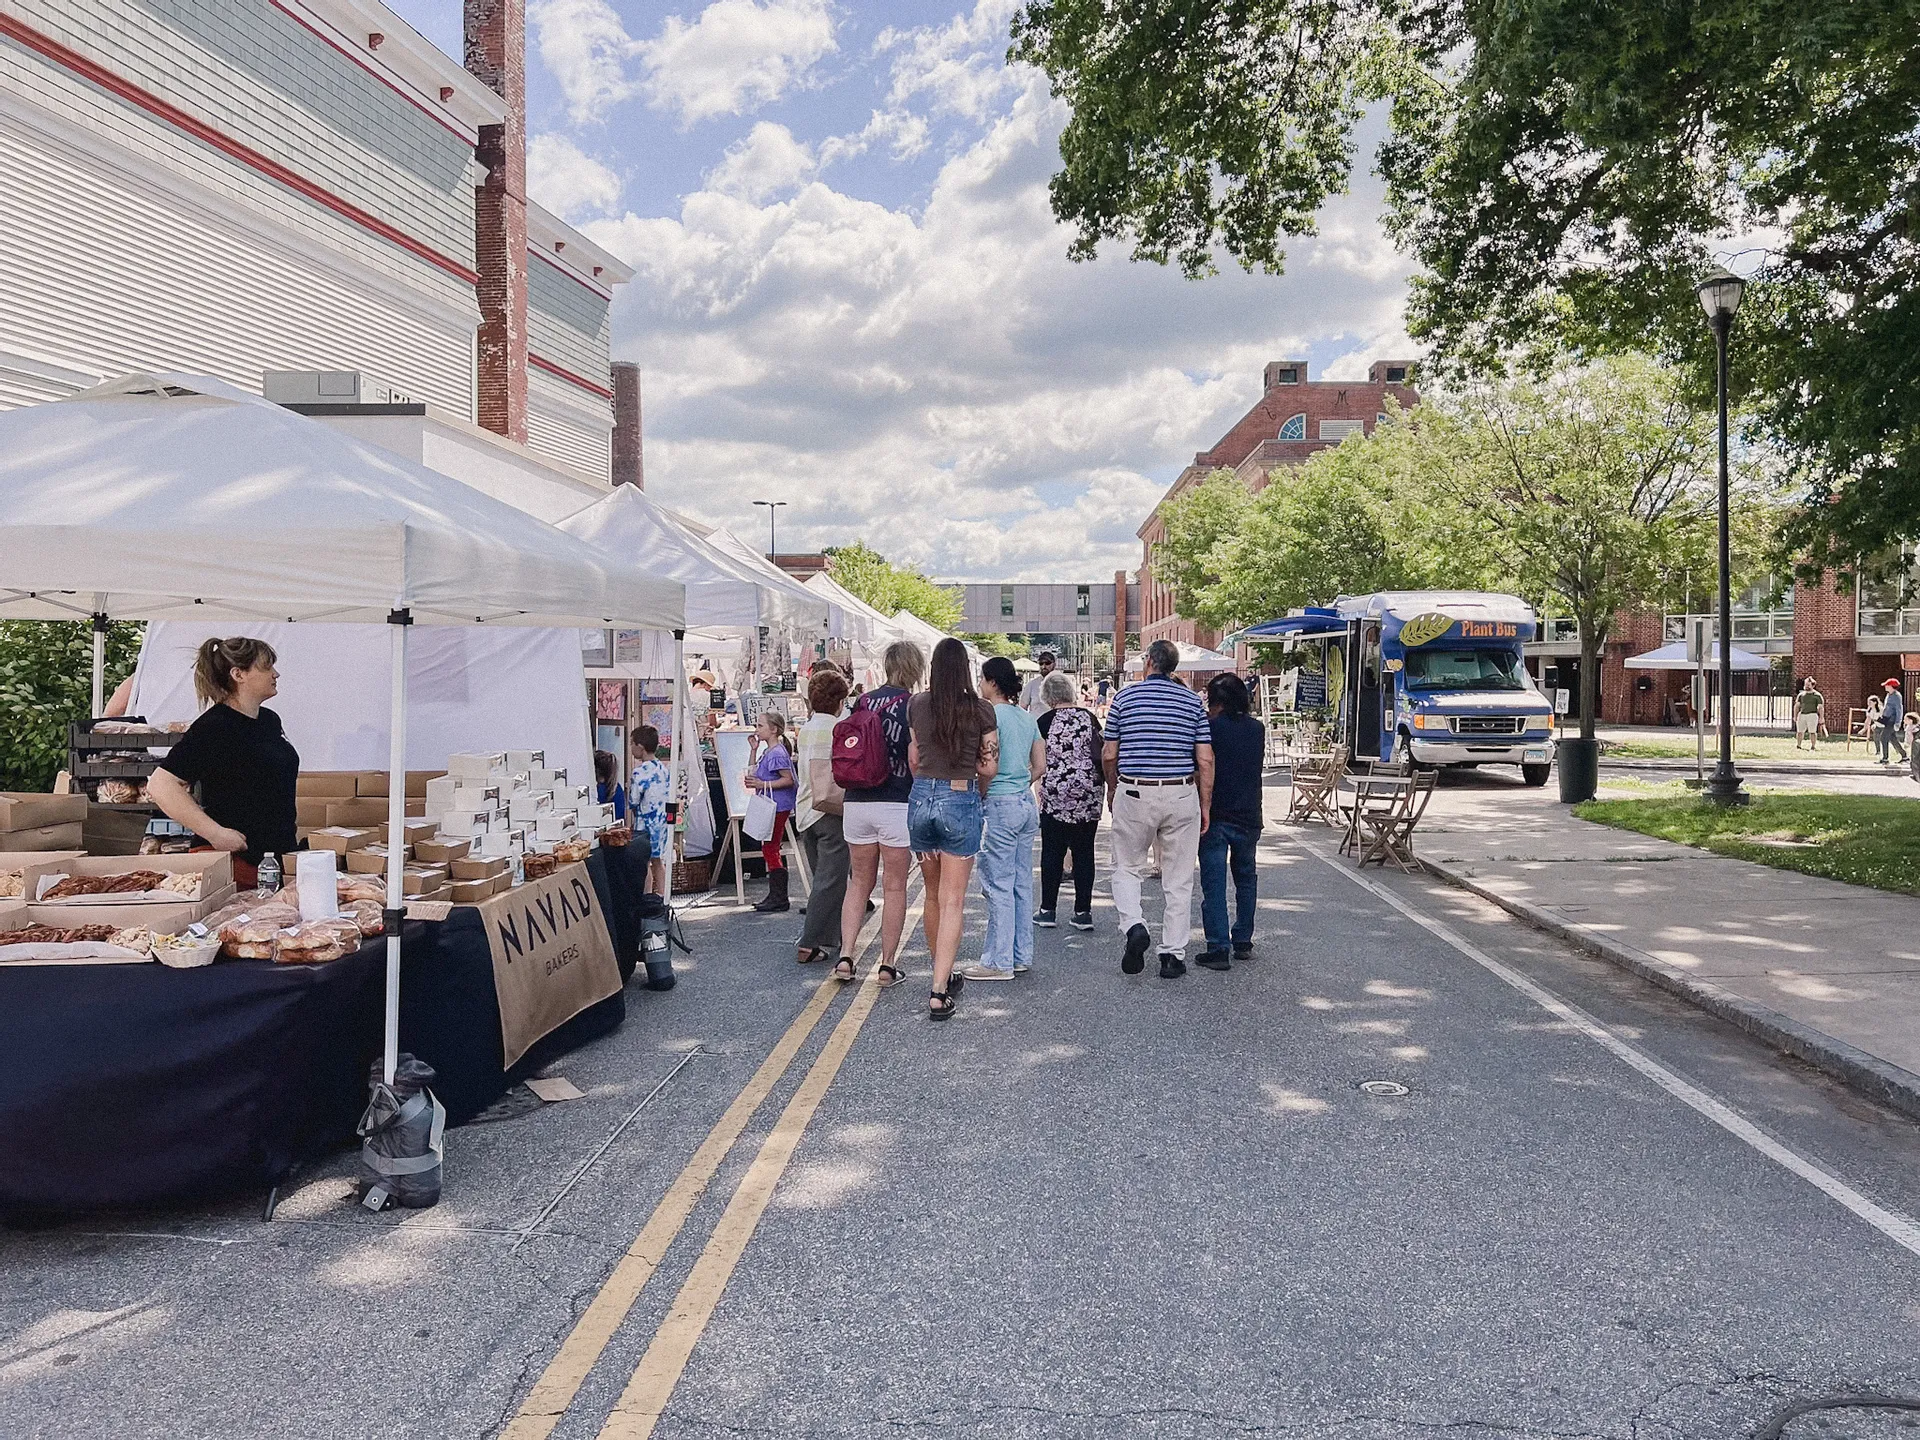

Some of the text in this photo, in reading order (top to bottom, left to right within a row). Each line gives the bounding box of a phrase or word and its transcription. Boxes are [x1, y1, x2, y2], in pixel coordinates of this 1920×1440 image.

[1461, 620, 1517, 637] Plant Bus
[1572, 662, 1578, 670] 2
[769, 698, 776, 706] A
[497, 878, 591, 964] NAVAD
[545, 943, 580, 976] BAKERS
